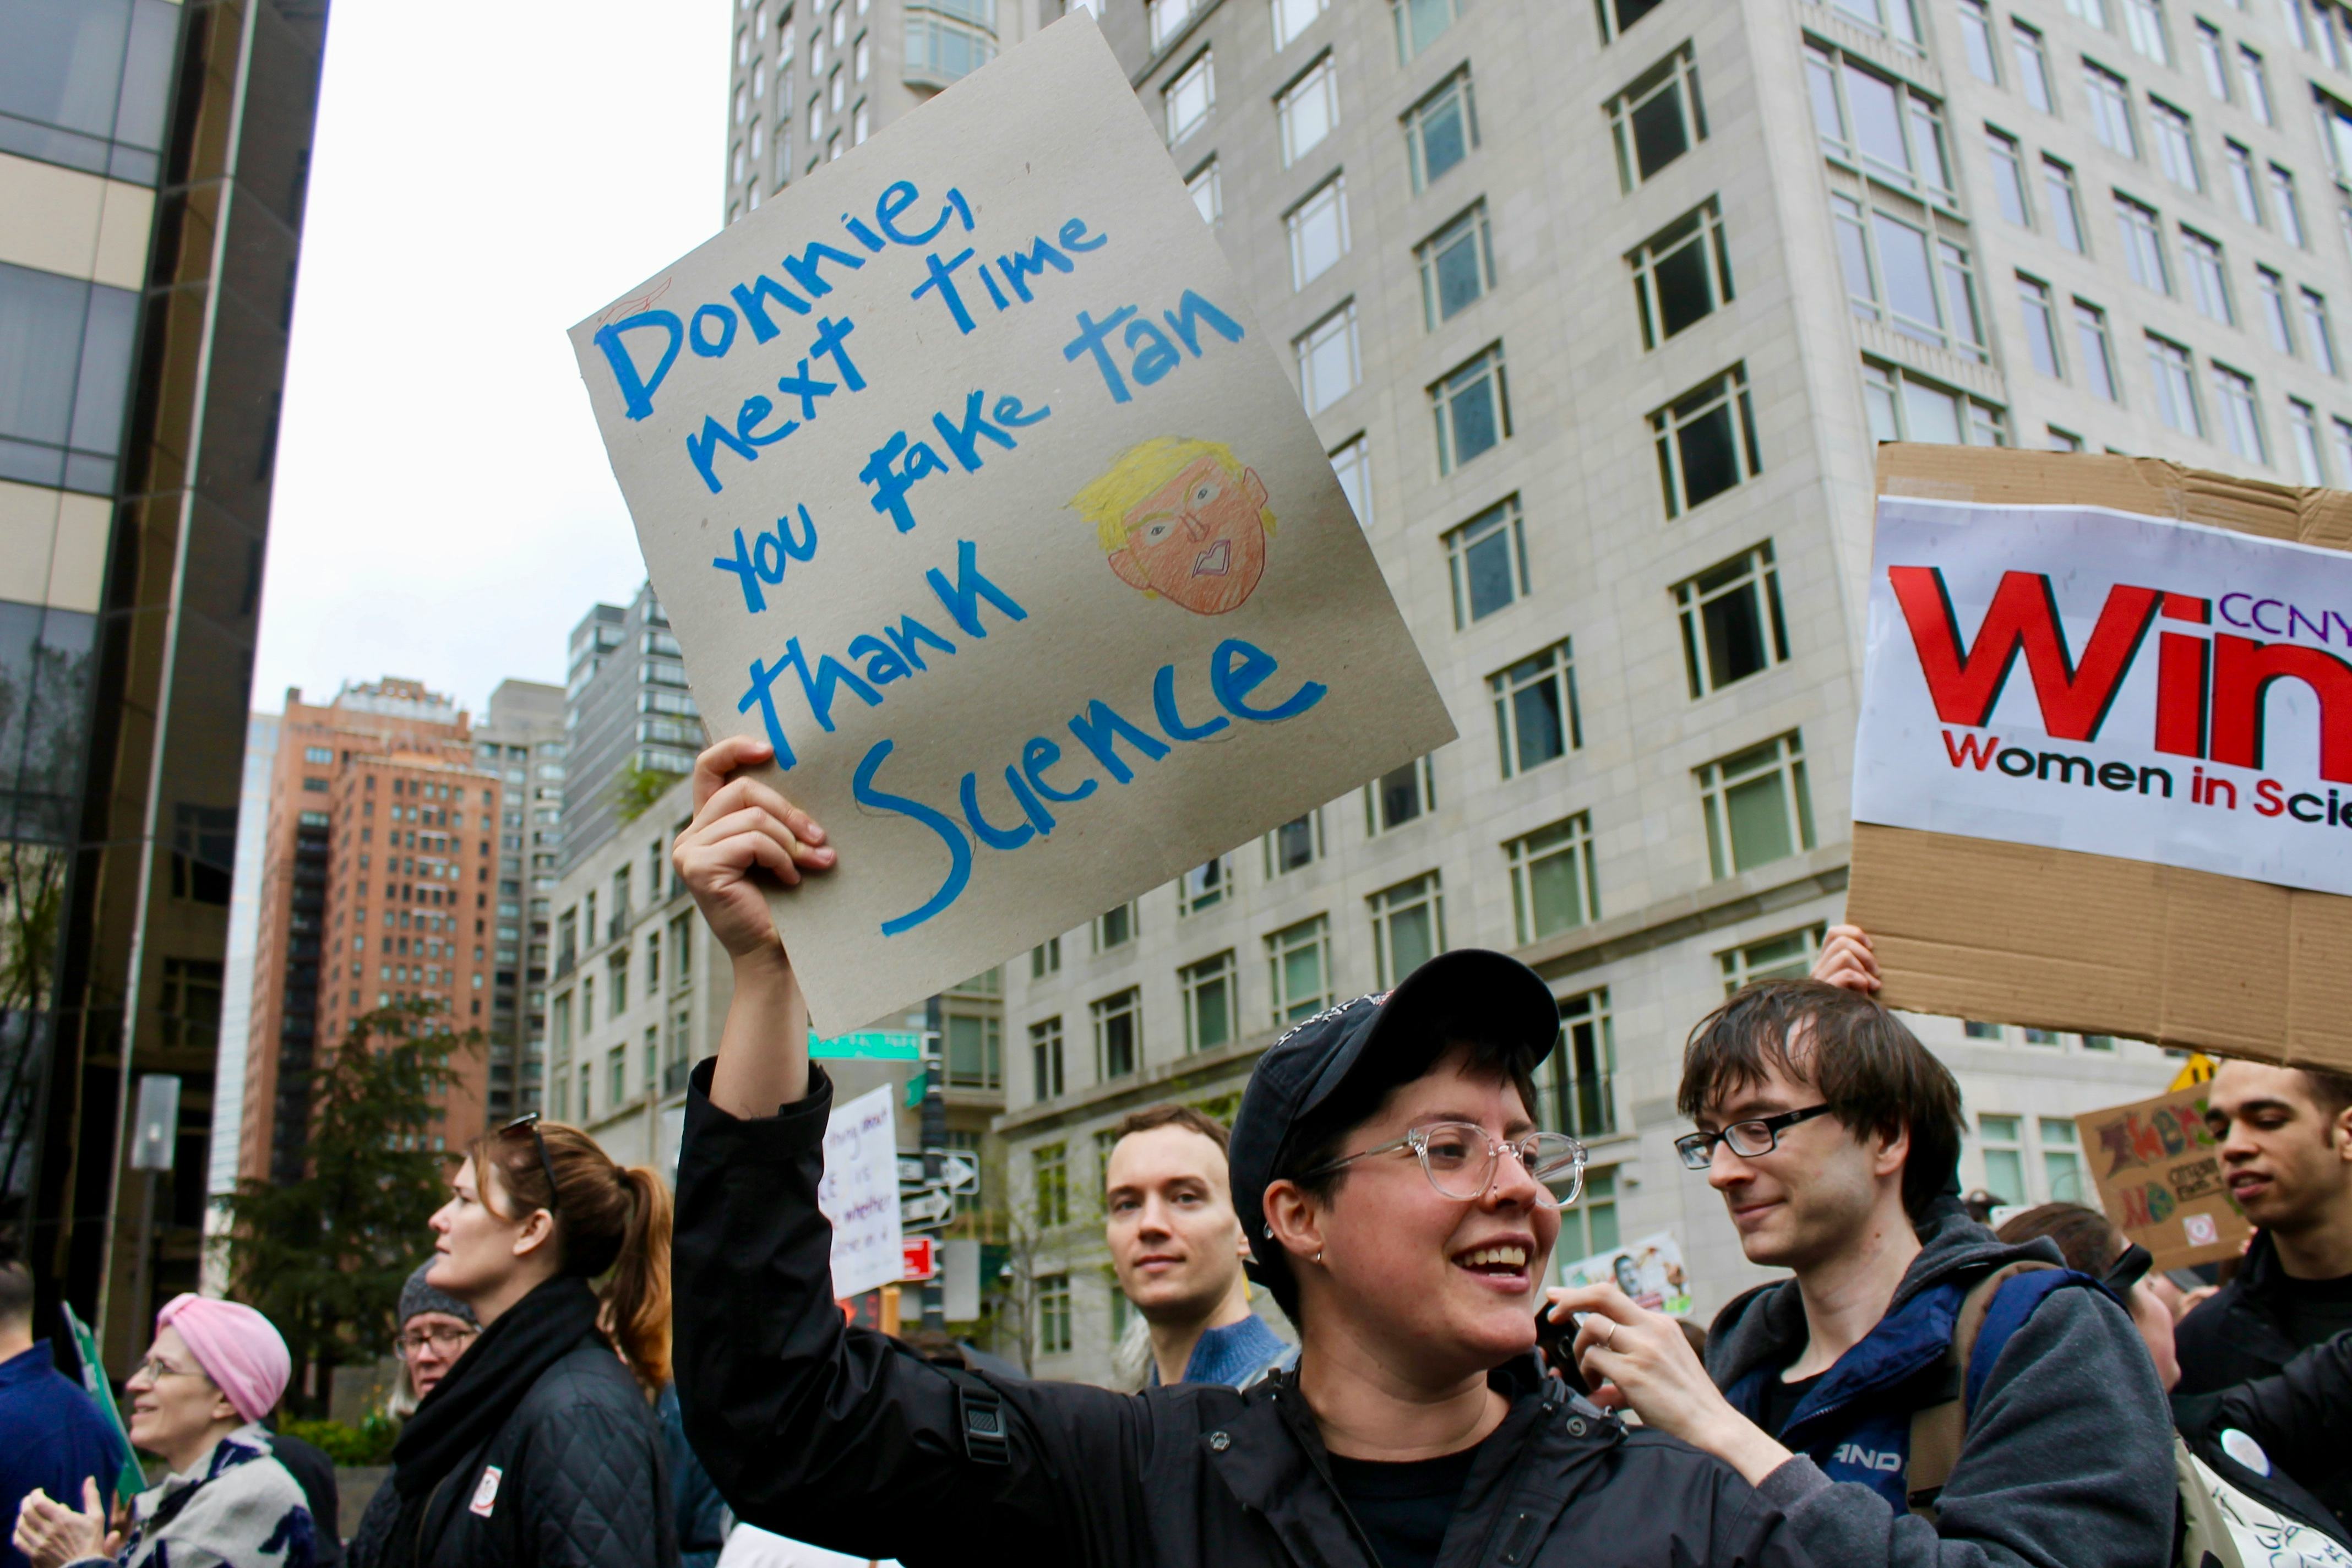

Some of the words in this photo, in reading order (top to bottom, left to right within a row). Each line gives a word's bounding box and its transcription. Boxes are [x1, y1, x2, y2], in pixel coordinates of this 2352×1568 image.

[594, 180, 976, 422] Donnie,
[686, 316, 867, 494] next
[852, 639, 1327, 937] Science
[1942, 729, 2173, 798] Women
[2192, 766, 2236, 810] in
